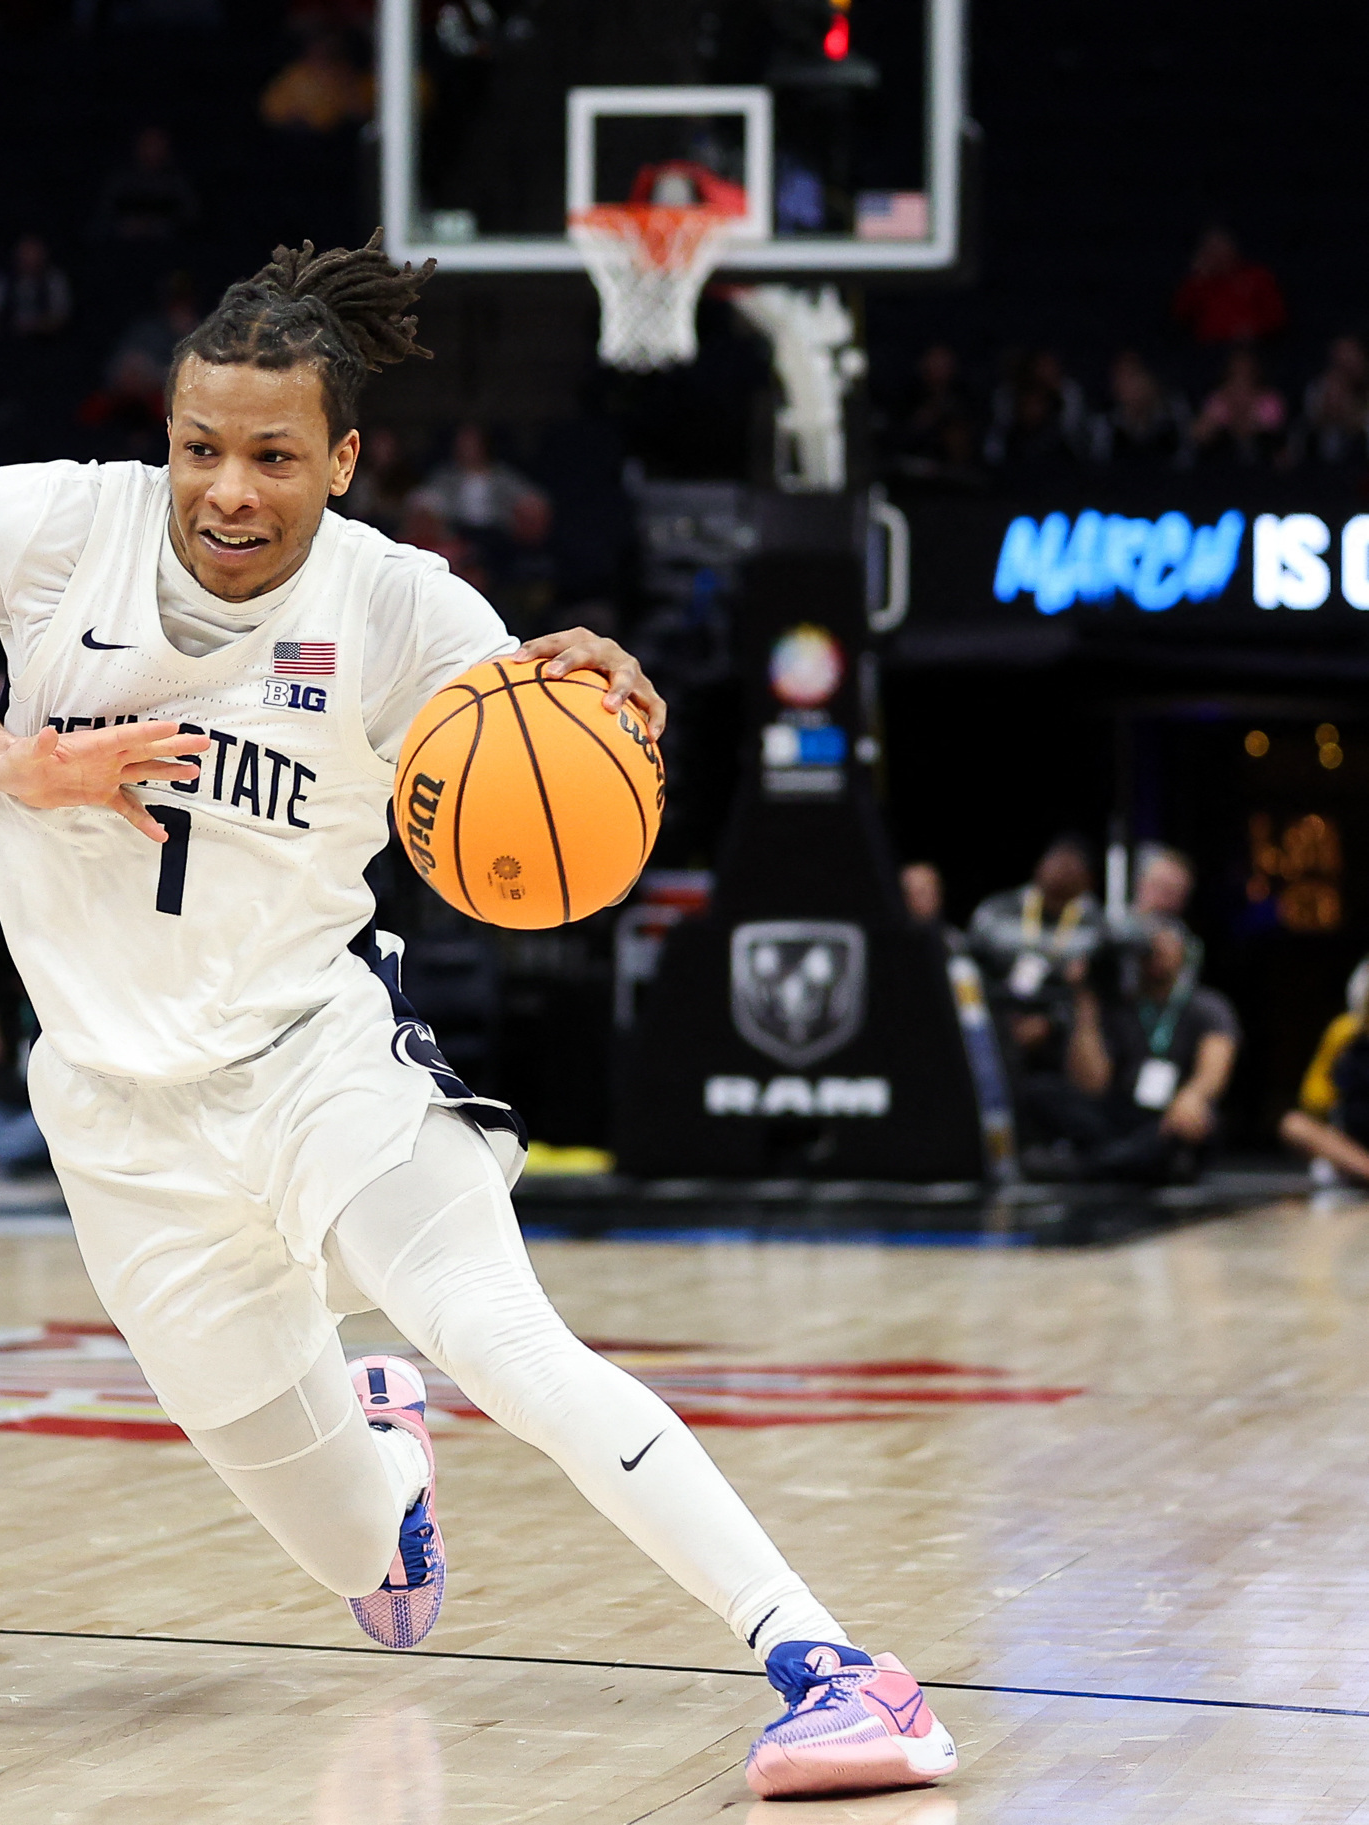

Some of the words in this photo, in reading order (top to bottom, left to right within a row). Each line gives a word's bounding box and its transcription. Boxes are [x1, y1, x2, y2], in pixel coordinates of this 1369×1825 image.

[993, 508, 1246, 616] MARCH
[1253, 512, 1331, 611] IS
[145, 803, 191, 916] 1
[703, 1073, 892, 1118] RAM
